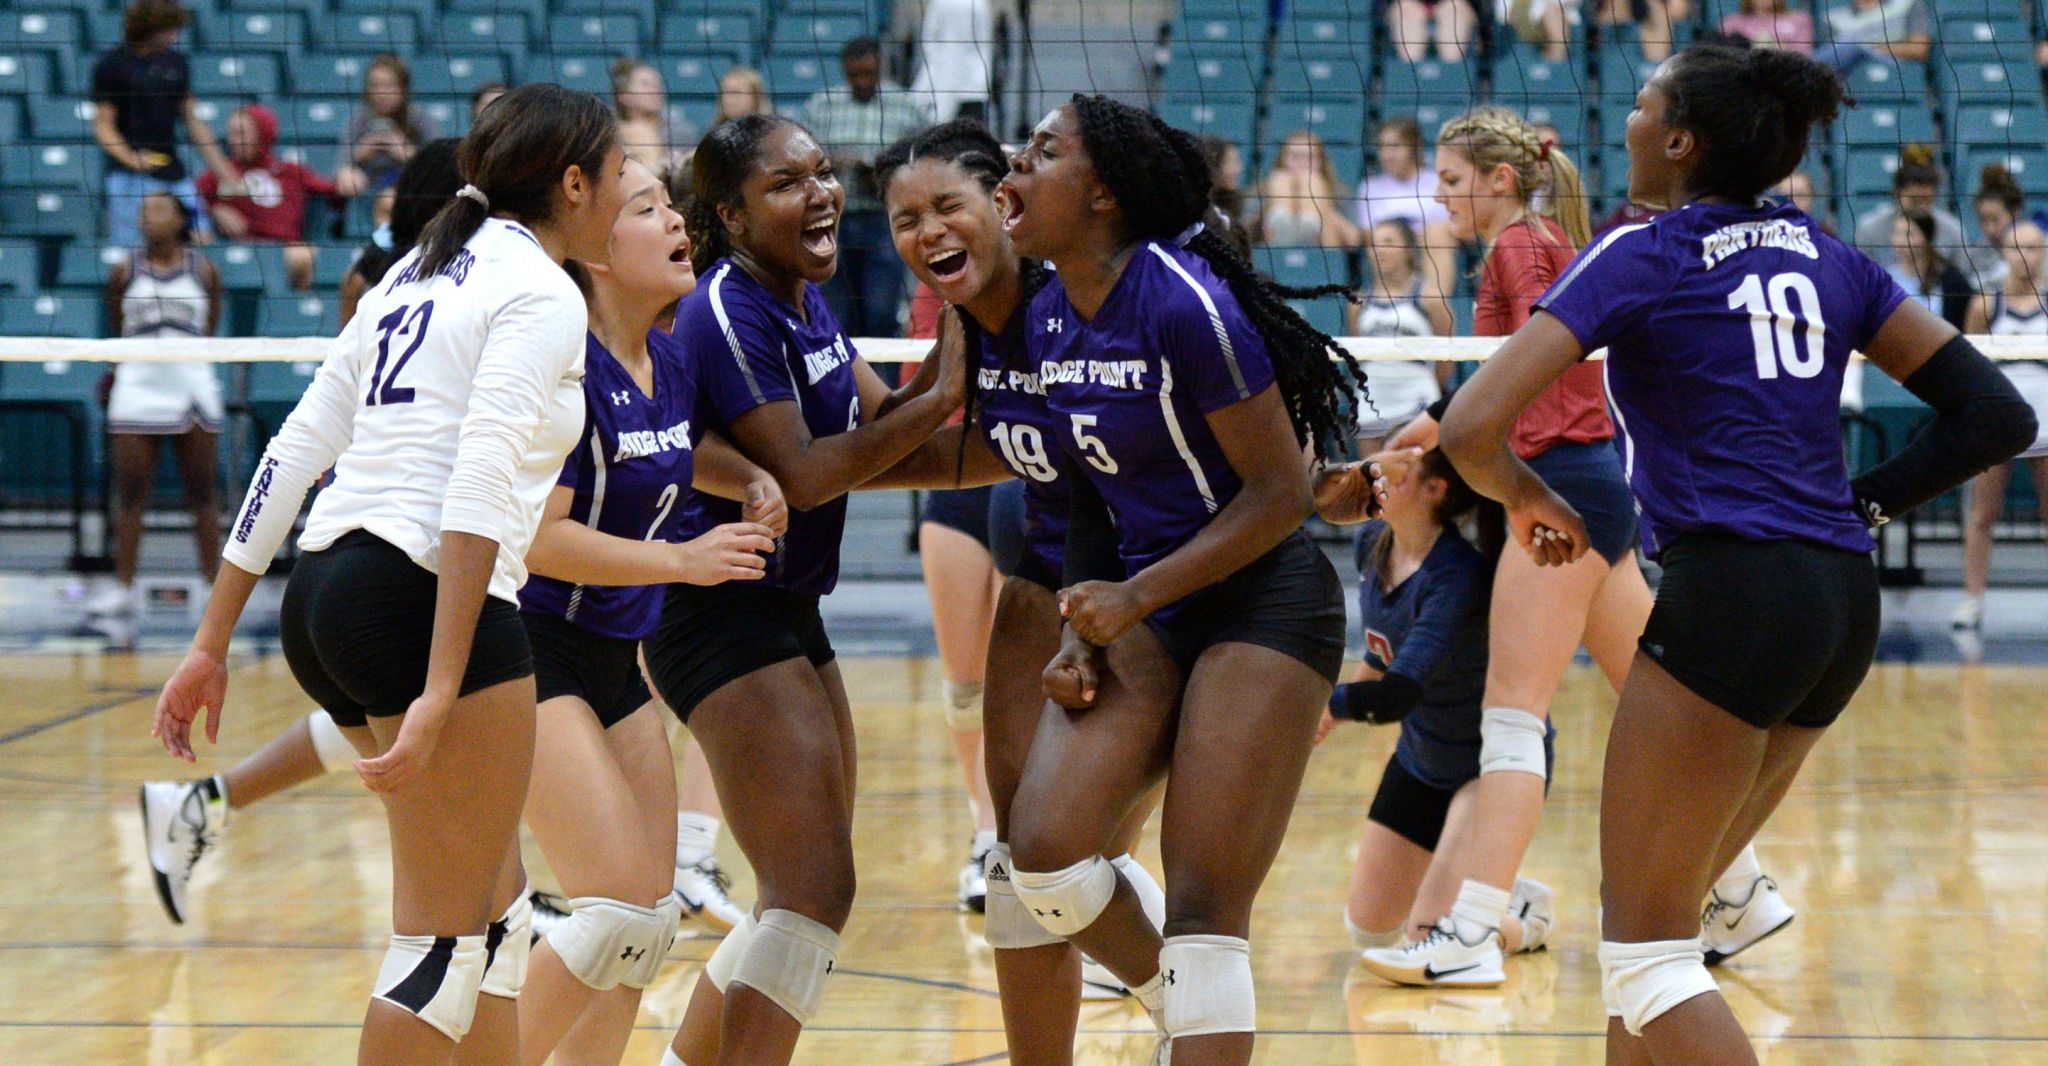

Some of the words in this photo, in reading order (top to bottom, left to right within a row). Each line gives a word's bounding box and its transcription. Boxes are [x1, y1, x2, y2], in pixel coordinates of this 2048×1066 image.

[365, 299, 434, 407] 12
[1727, 272, 1825, 380] 10
[1088, 360, 1148, 390] POINT
[990, 421, 1058, 482] 19
[1070, 413, 1119, 475] 5
[235, 457, 279, 544] PANTHERS
[644, 483, 679, 543] 2
